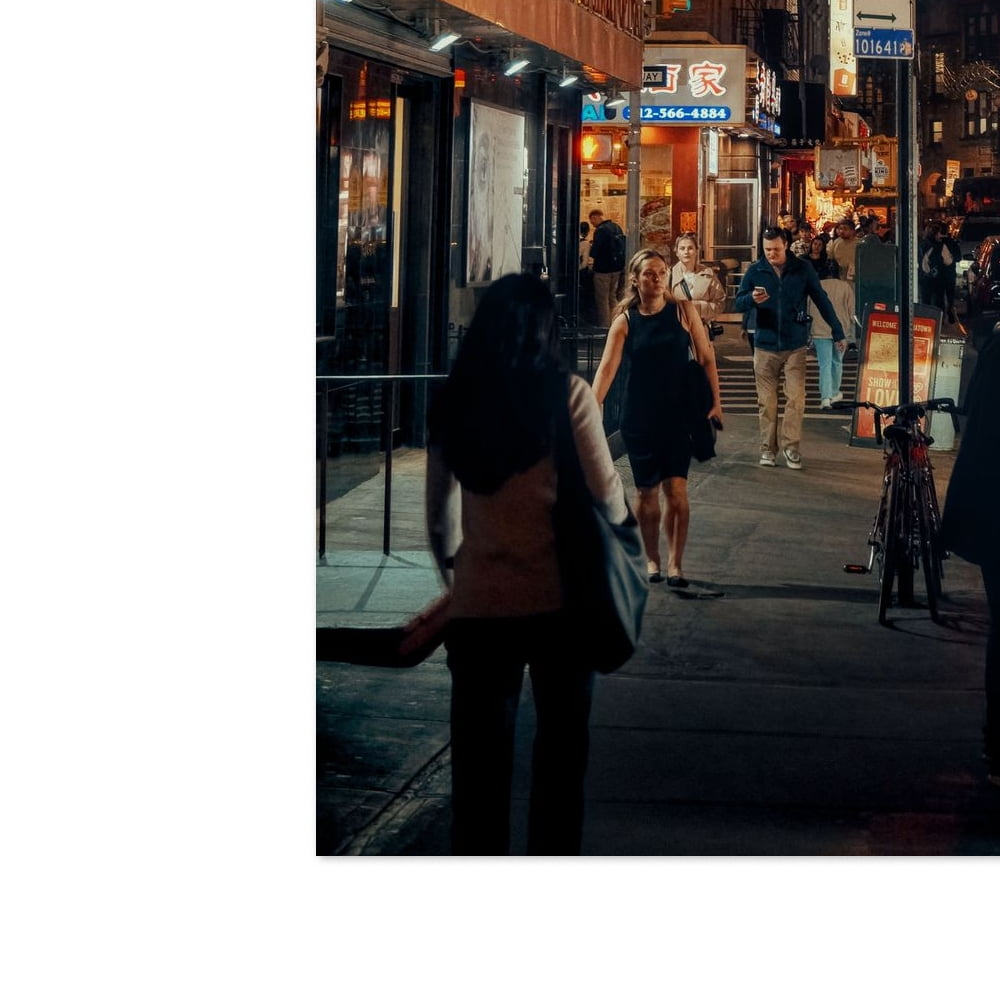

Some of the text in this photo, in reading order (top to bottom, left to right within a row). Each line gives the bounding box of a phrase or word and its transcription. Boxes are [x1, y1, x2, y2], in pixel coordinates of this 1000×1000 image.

[856, 39, 898, 55] 101641
[643, 72, 658, 81] AY
[626, 107, 728, 119] 12-566-4884
[872, 320, 898, 329] WELCOME
[869, 377, 892, 387] SHOW
[866, 388, 899, 406] LOV
